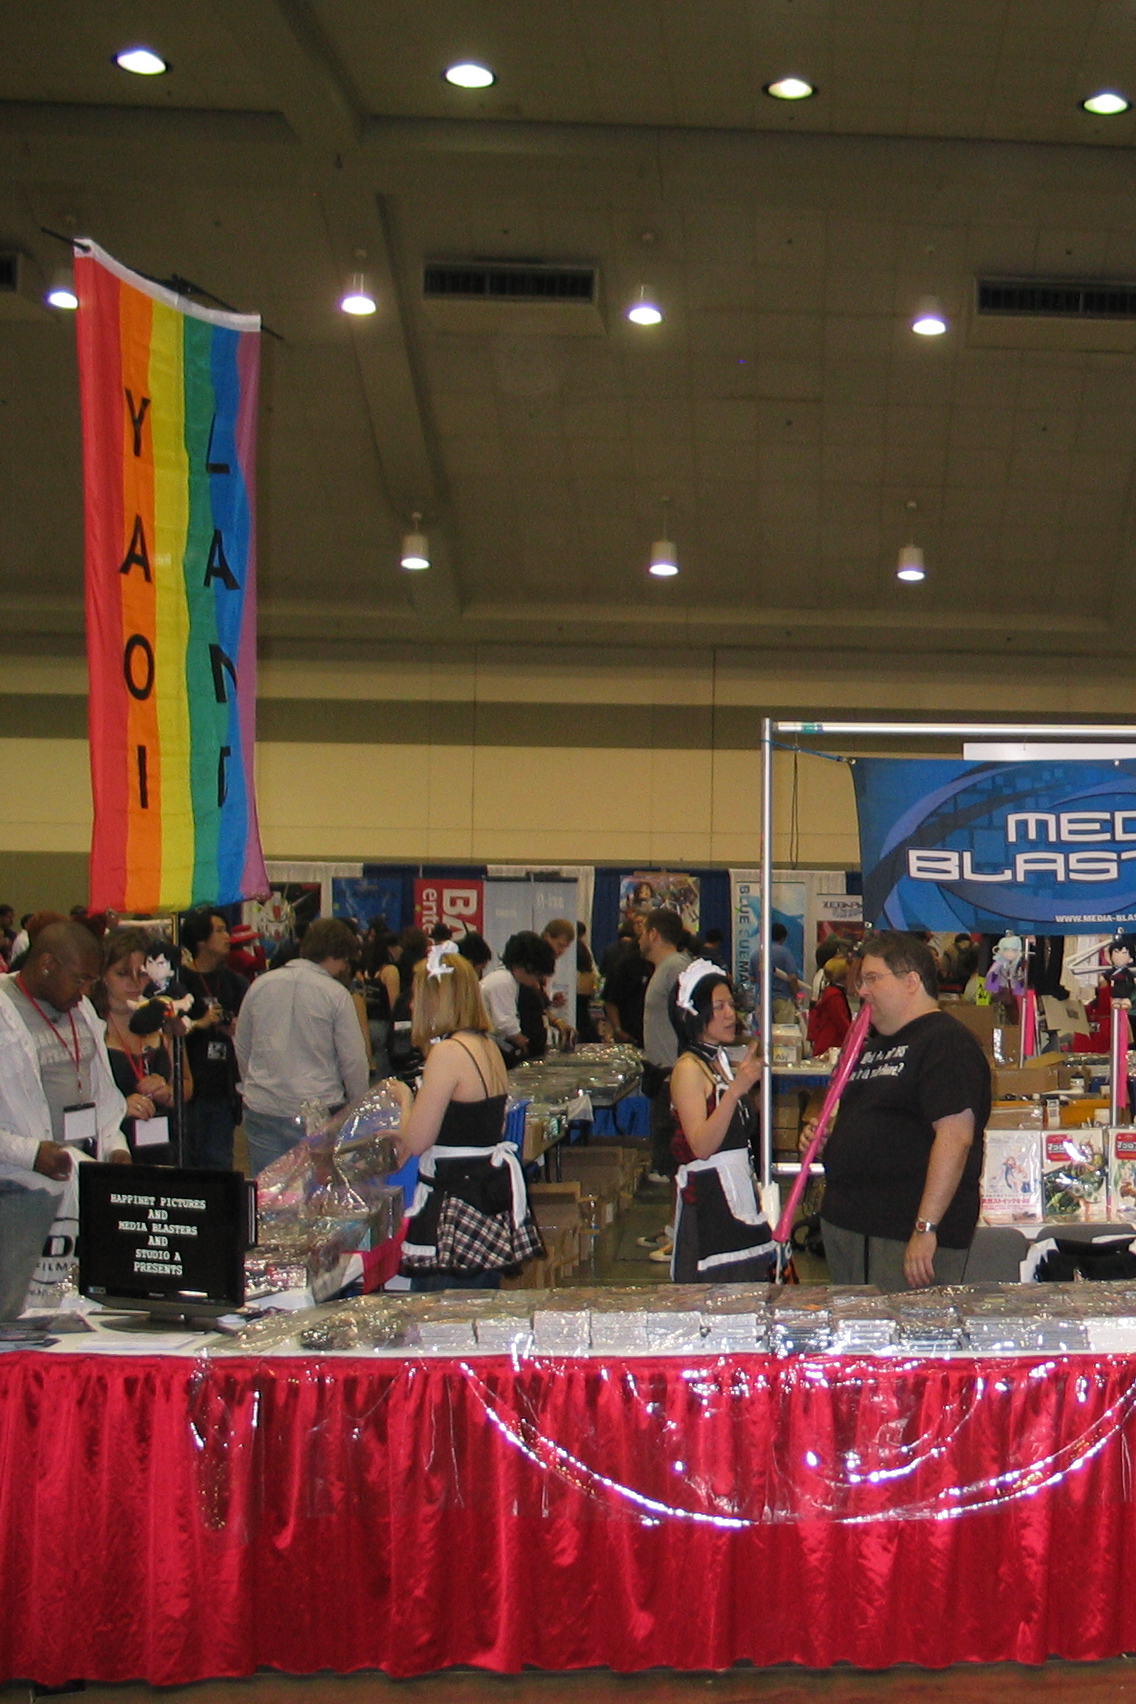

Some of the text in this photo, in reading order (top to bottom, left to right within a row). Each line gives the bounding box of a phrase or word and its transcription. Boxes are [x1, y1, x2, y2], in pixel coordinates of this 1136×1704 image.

[119, 389, 156, 809] YAOI
[739, 885, 750, 924] BLUE
[110, 1193, 207, 1210] HAPPINET PICTURES
[148, 1209, 168, 1221] AND
[118, 1220, 198, 1236] MEDIA BLASTERS
[148, 1235, 168, 1246] AND
[135, 1249, 182, 1262] STUDIO A
[133, 1261, 183, 1276] PRESENTS
